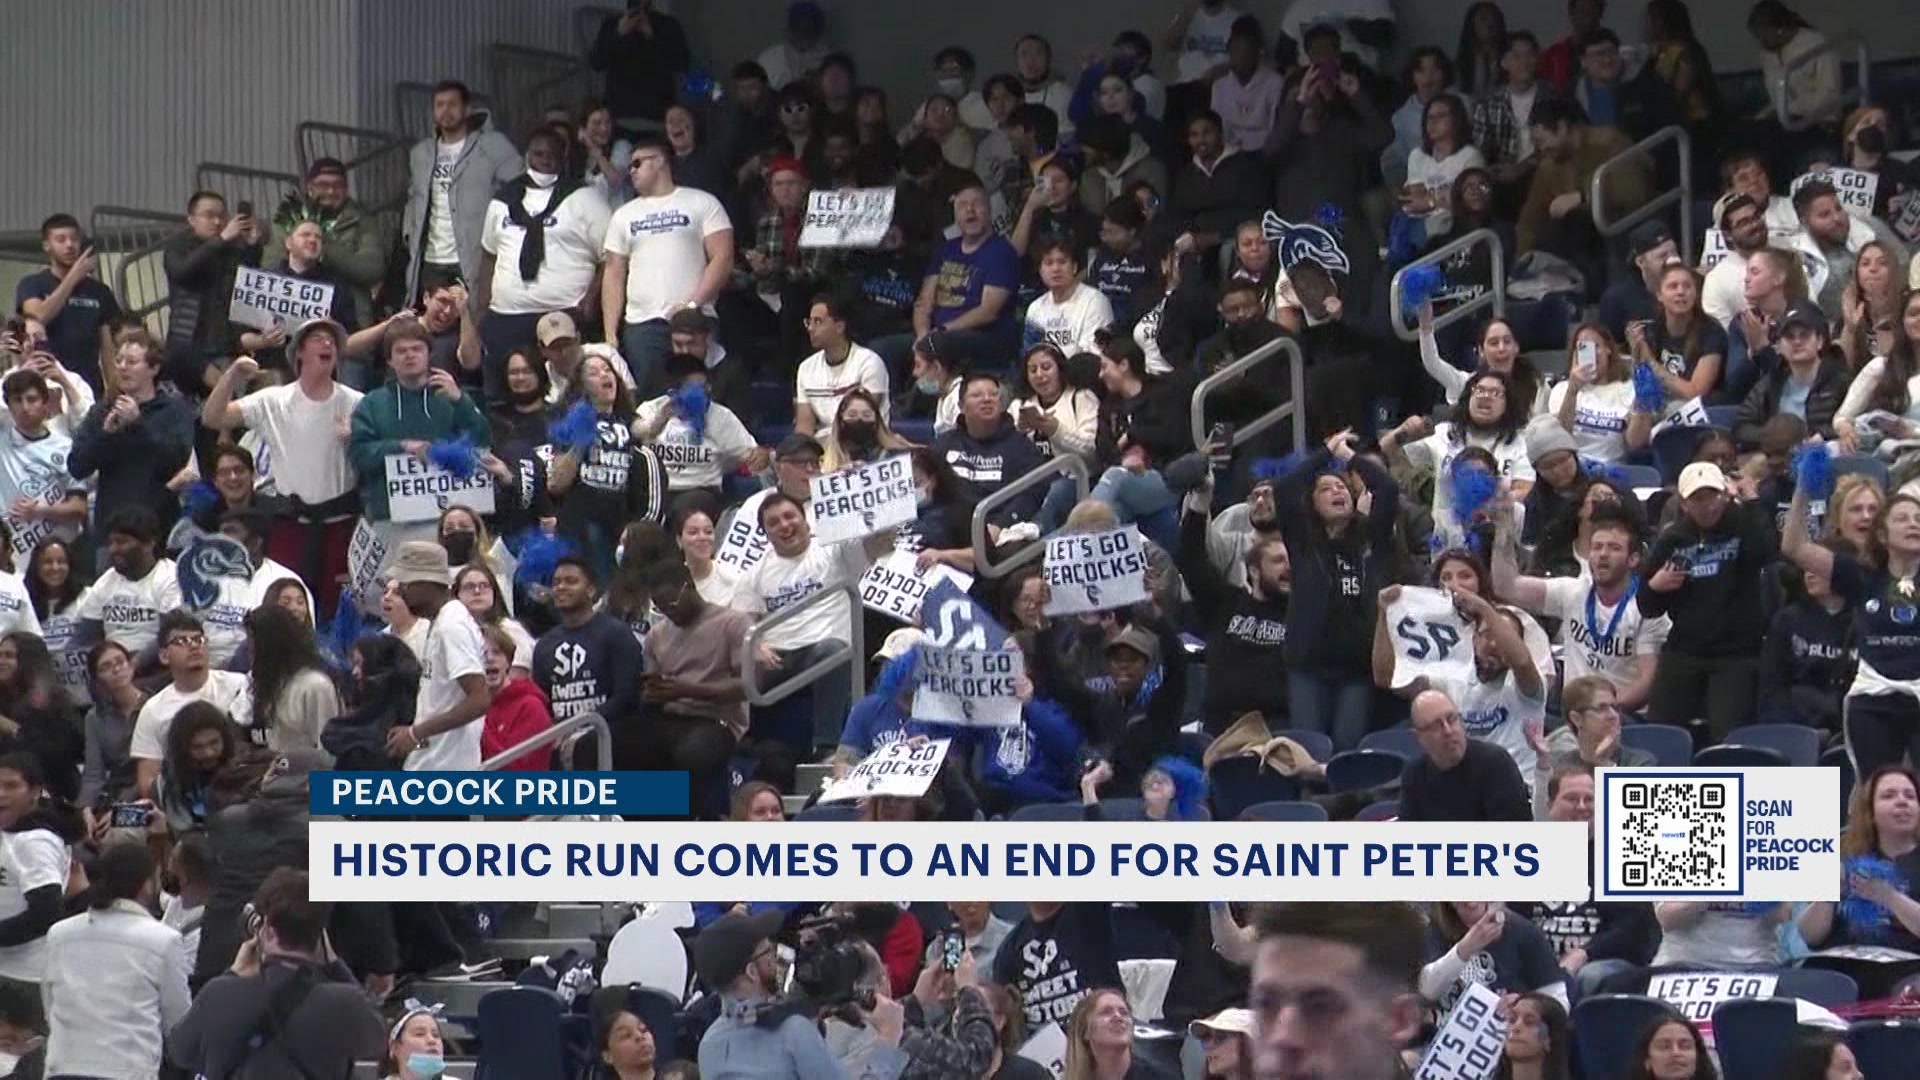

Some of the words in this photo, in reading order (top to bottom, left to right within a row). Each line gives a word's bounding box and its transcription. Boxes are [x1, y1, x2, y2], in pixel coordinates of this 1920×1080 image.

[1841, 174, 1866, 188] GO
[234, 287, 329, 319] PEACOCKS!
[244, 272, 294, 297] LET'S
[300, 284, 324, 303] GO
[596, 421, 630, 448] SP
[819, 469, 872, 497] LET'S
[879, 461, 902, 479] GO
[814, 479, 913, 520] PEACOCKS!
[729, 520, 751, 547] GO
[1049, 537, 1092, 561] LET'S
[1099, 531, 1128, 555] GO
[1044, 552, 1146, 586] PEACOCKS!
[1397, 615, 1461, 661] SP
[553, 641, 586, 679] SP
[983, 654, 1011, 673] GO
[1023, 939, 1058, 979] SP
[1658, 976, 1719, 999] LET'S
[1728, 979, 1762, 998] GO
[1455, 996, 1488, 1032] GO
